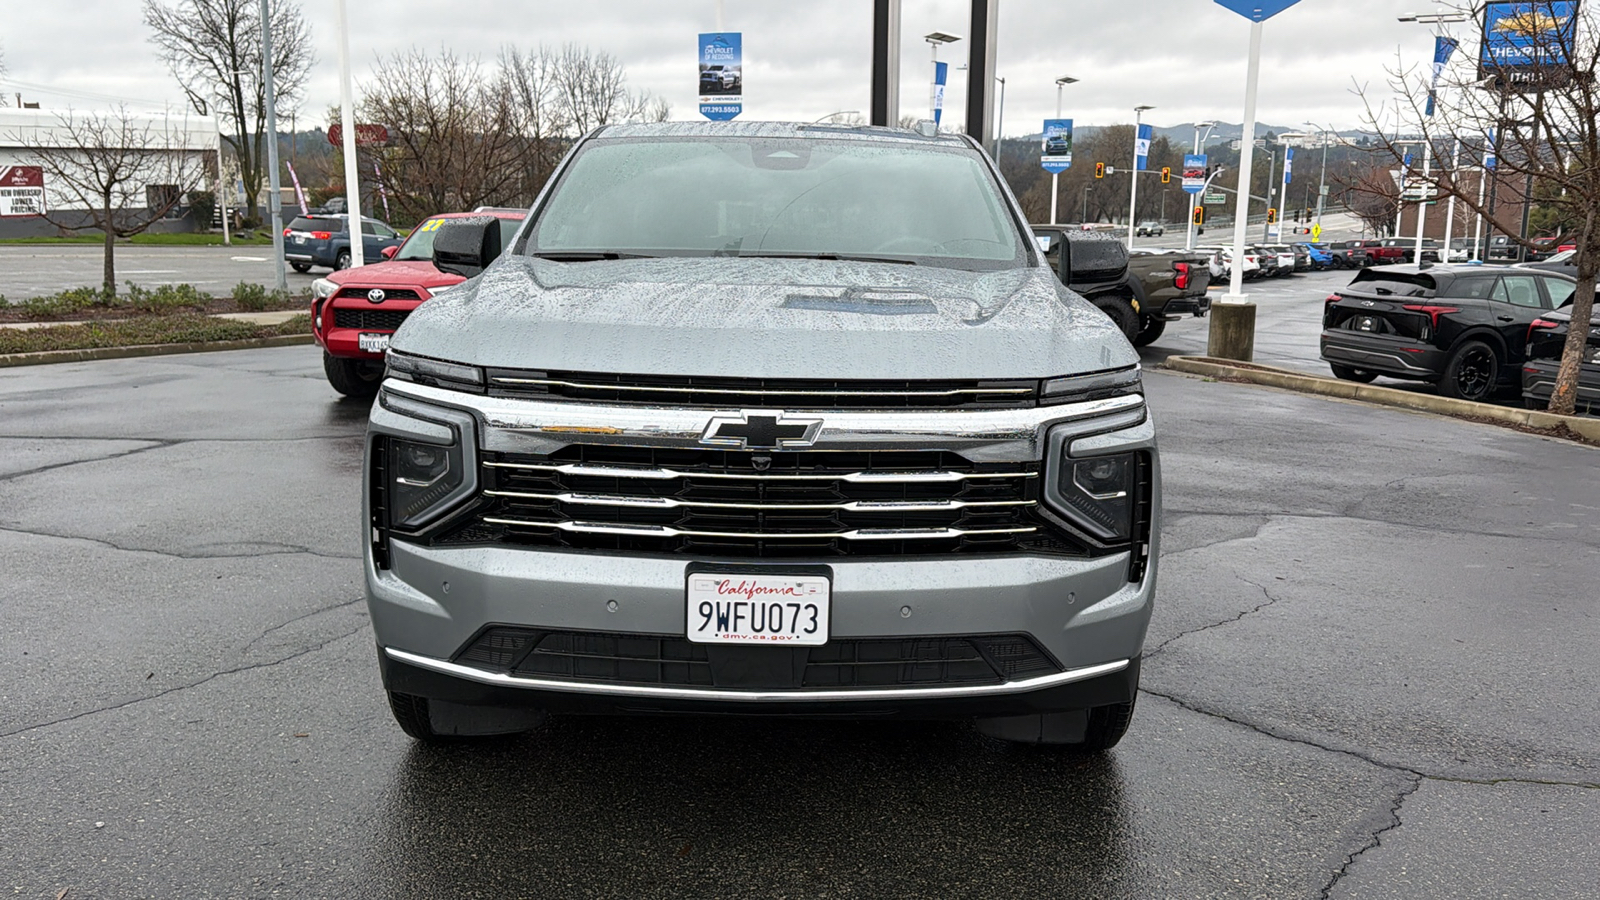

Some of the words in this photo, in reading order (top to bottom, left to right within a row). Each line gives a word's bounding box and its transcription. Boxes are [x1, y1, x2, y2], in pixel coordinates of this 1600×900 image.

[1, 189, 11, 197] NEW
[13, 189, 41, 197] OWNERSHIP
[12, 198, 33, 206] LOWER
[718, 579, 803, 600] California
[698, 601, 818, 633] 9WFU073
